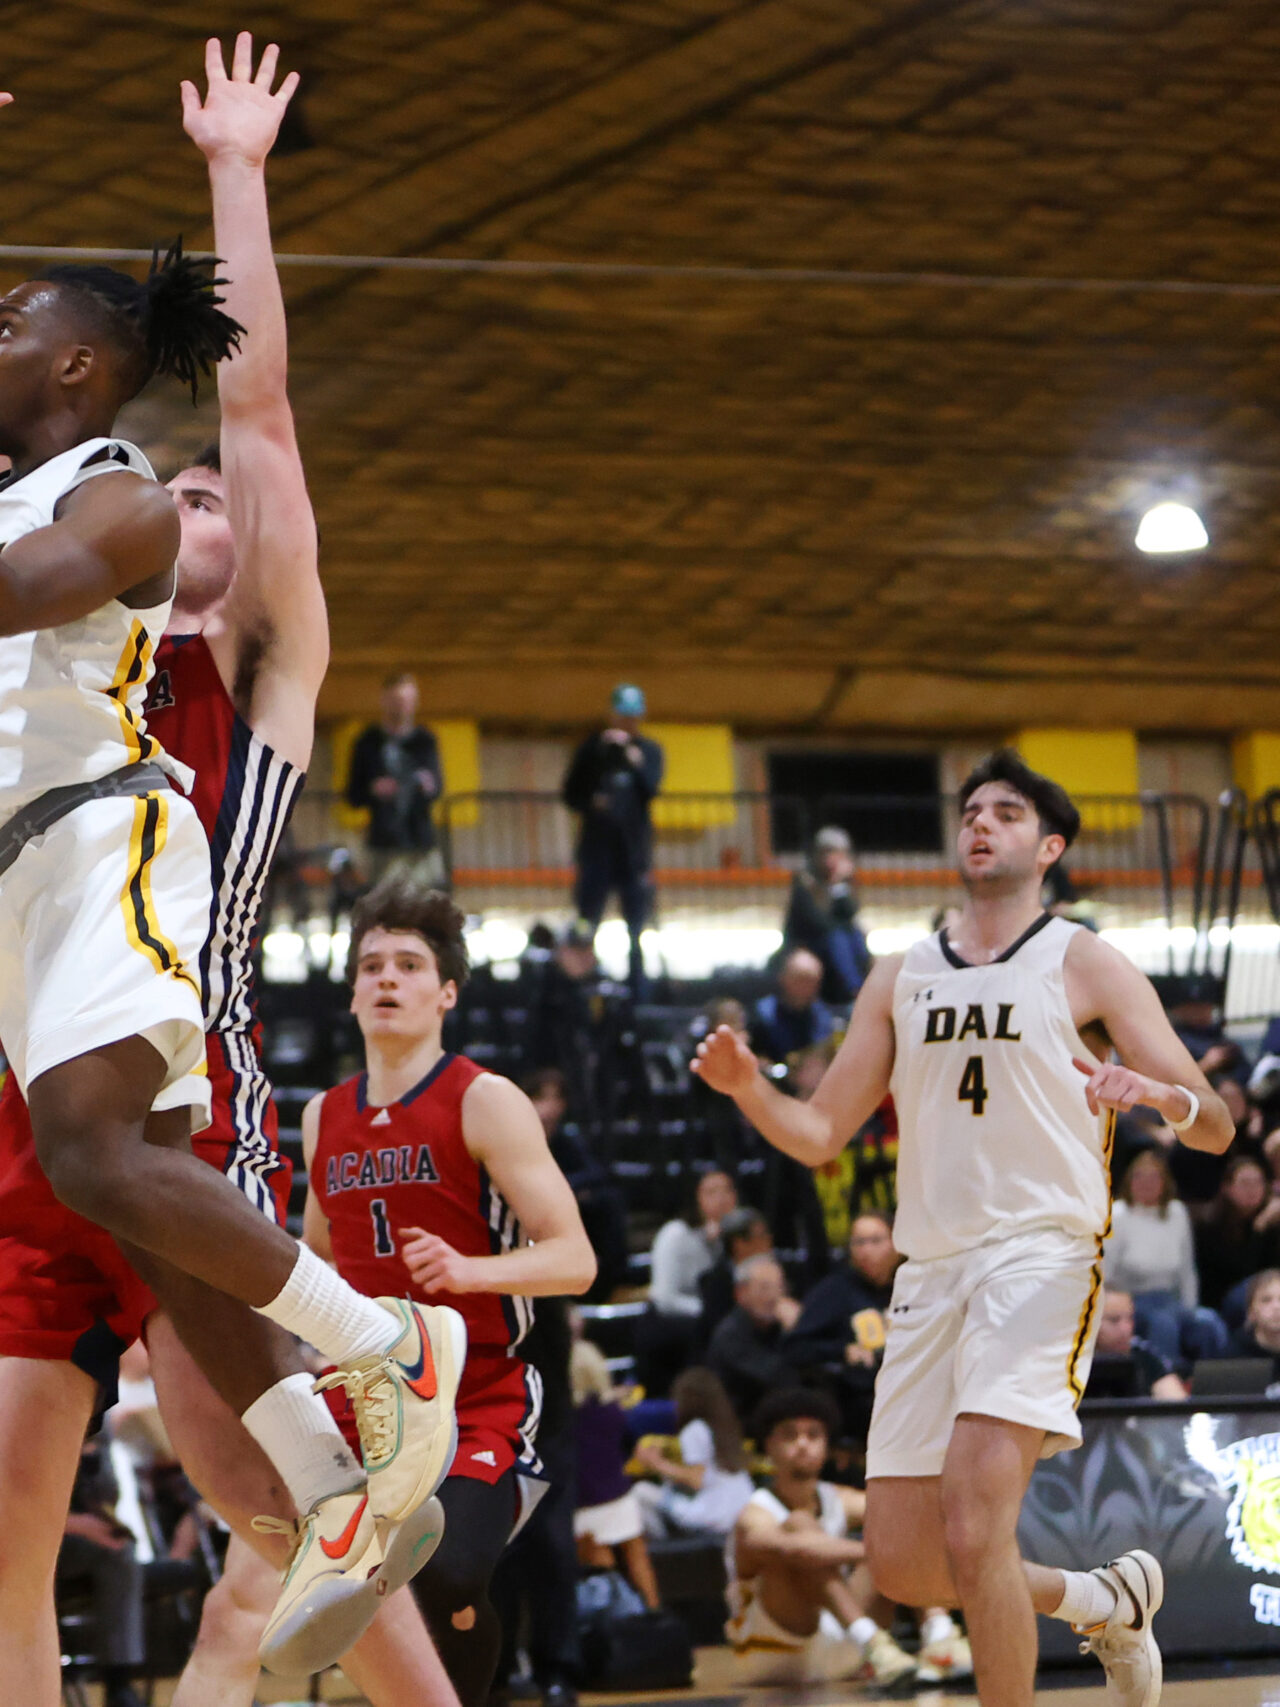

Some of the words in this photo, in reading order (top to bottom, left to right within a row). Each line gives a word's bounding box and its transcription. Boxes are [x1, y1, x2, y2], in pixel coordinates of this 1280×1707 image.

[924, 1002, 1022, 1044] DAL
[958, 1055, 988, 1116] 4
[326, 1144, 440, 1196] ACADIA
[369, 1198, 395, 1258] 1
